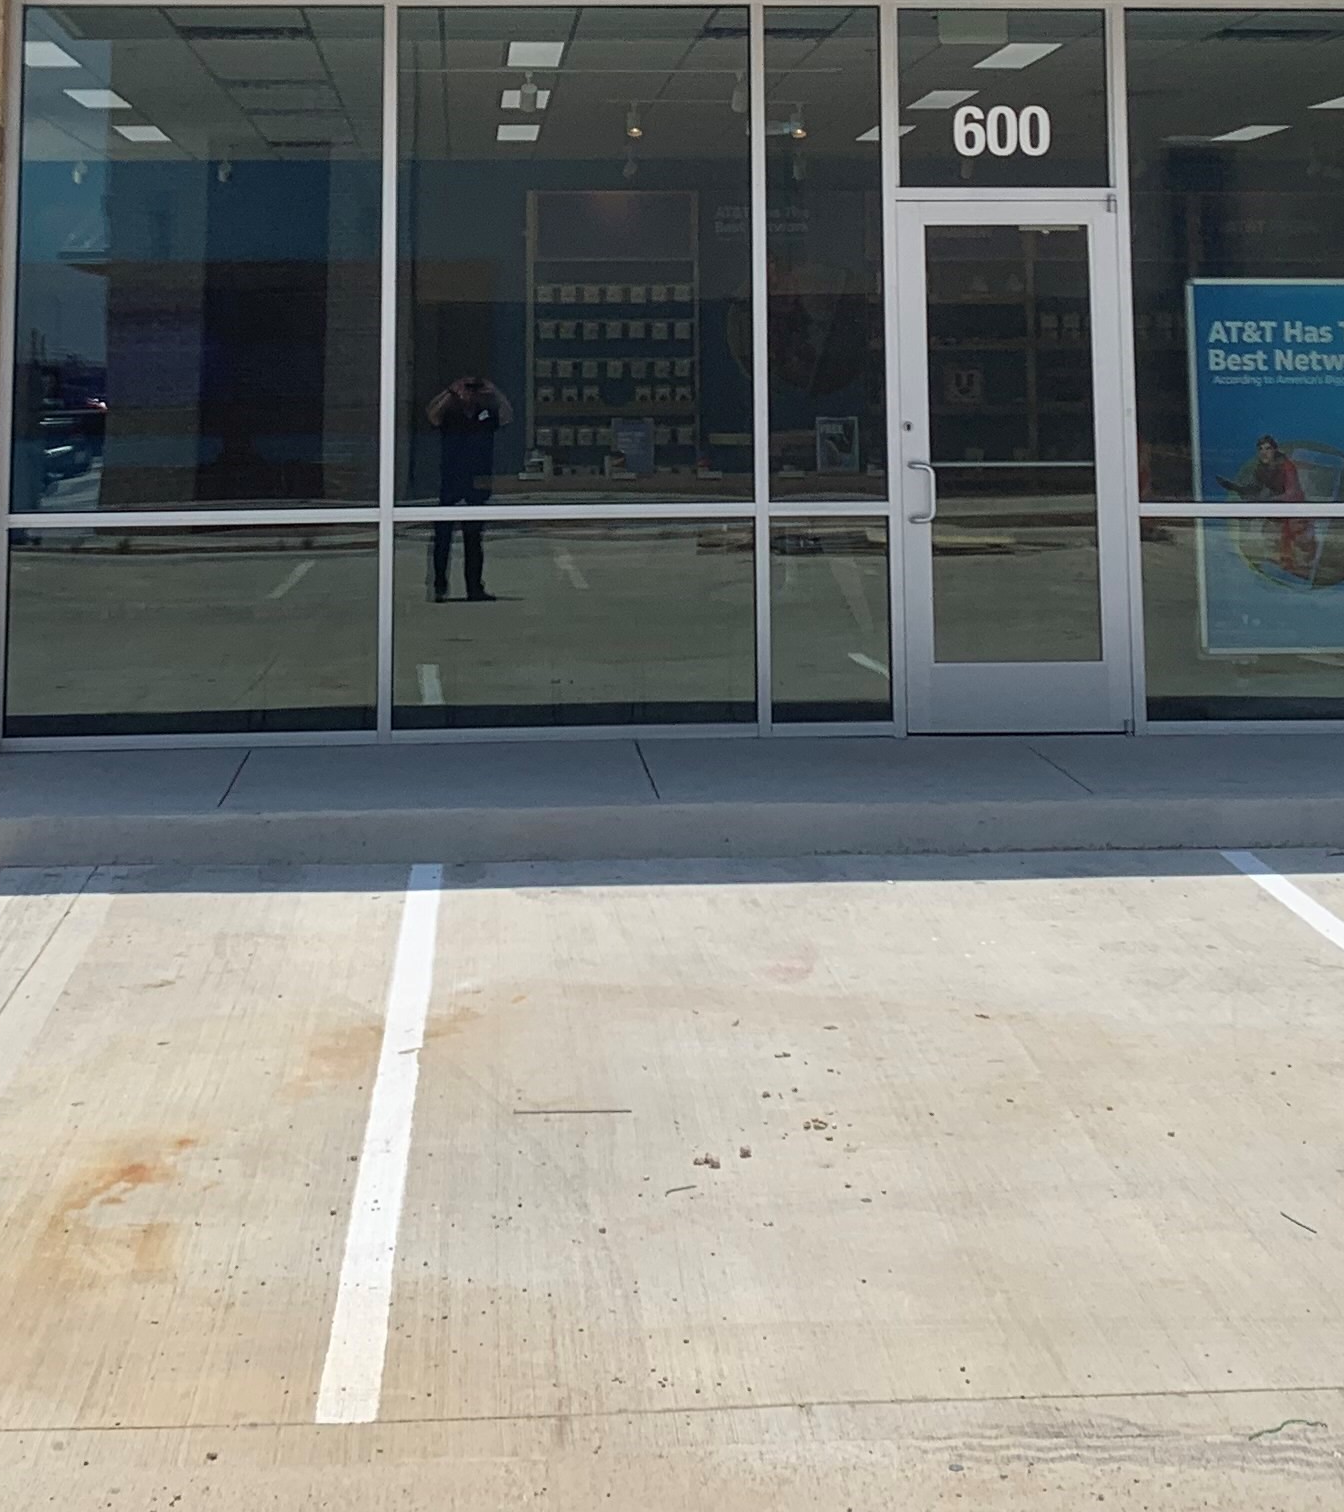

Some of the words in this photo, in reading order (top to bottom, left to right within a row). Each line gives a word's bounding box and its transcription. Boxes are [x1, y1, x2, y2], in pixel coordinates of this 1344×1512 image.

[953, 104, 1051, 157] 600
[1208, 320, 1278, 343] AT&T
[1283, 320, 1334, 343] Has
[1208, 349, 1269, 371] Best
[1213, 374, 1262, 387] According
[1263, 375, 1275, 384] to
